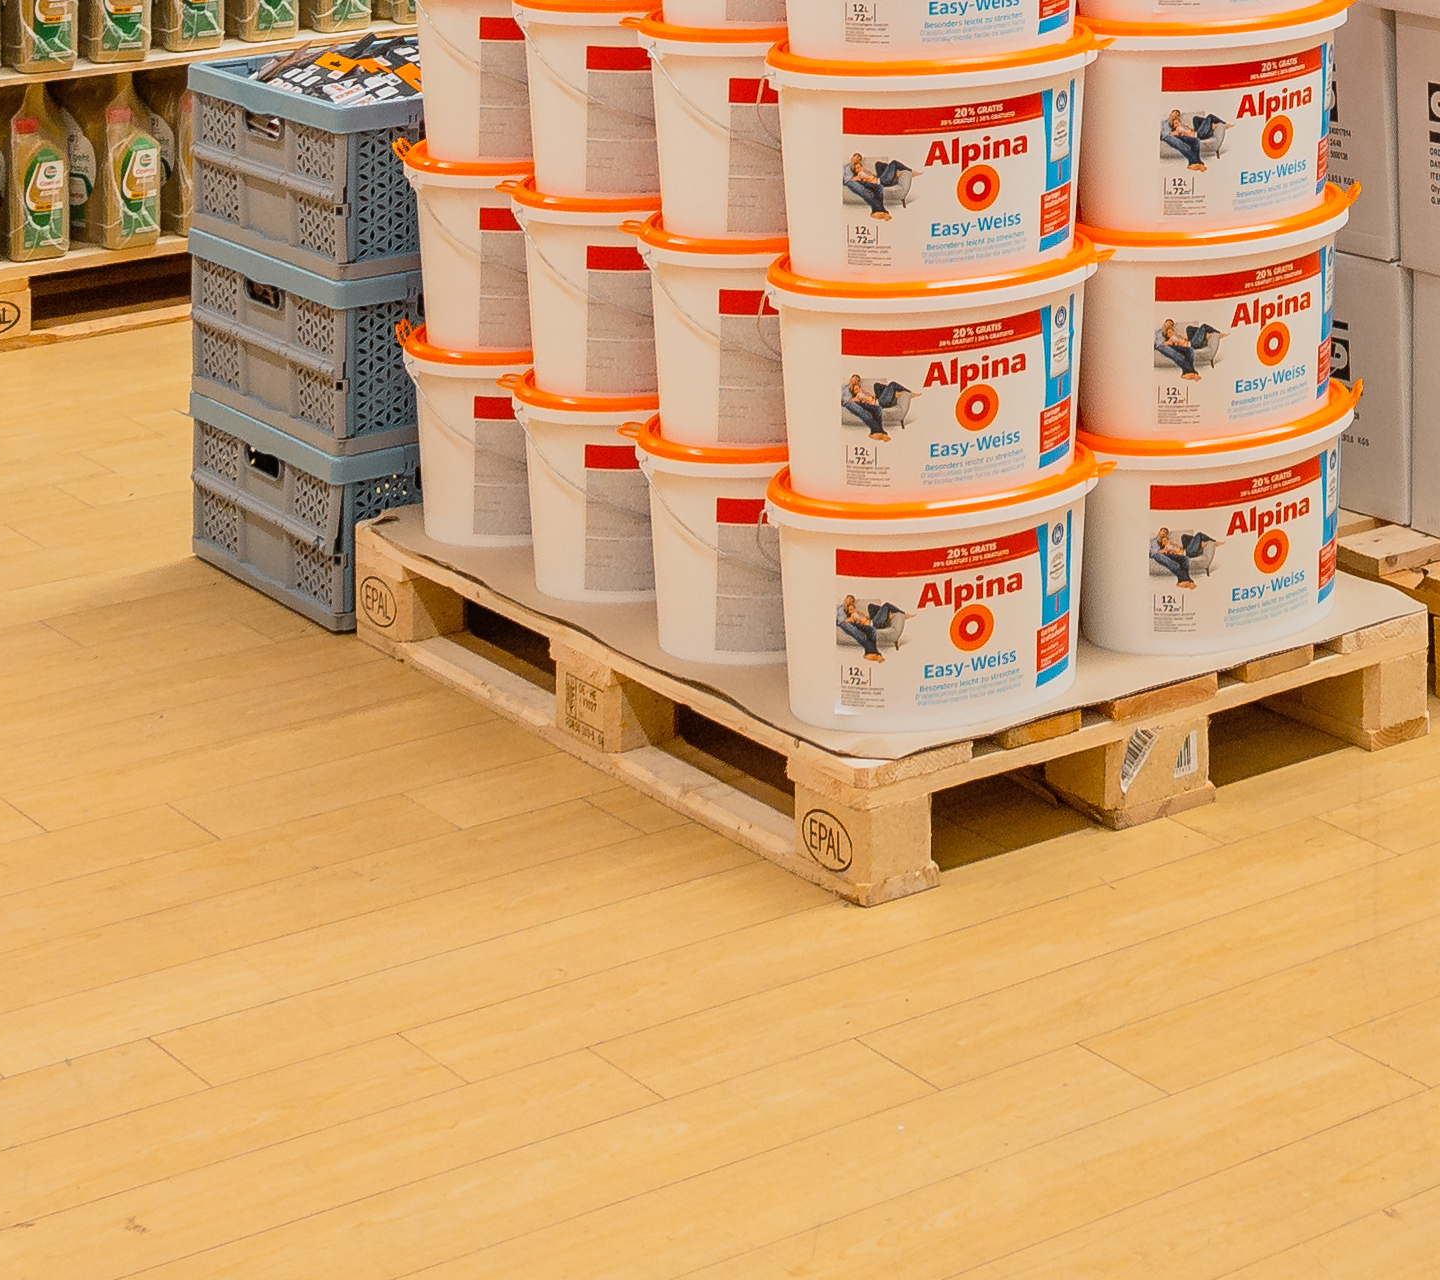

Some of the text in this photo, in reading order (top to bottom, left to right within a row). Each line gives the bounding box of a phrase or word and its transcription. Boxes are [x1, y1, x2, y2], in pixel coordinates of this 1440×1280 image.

[924, 352, 1027, 391] Alpina
[1226, 497, 1310, 538] Alpina
[917, 570, 1023, 611] Alpina
[924, 650, 1016, 679] Easy-Weiss
[806, 817, 849, 866] EPAL
